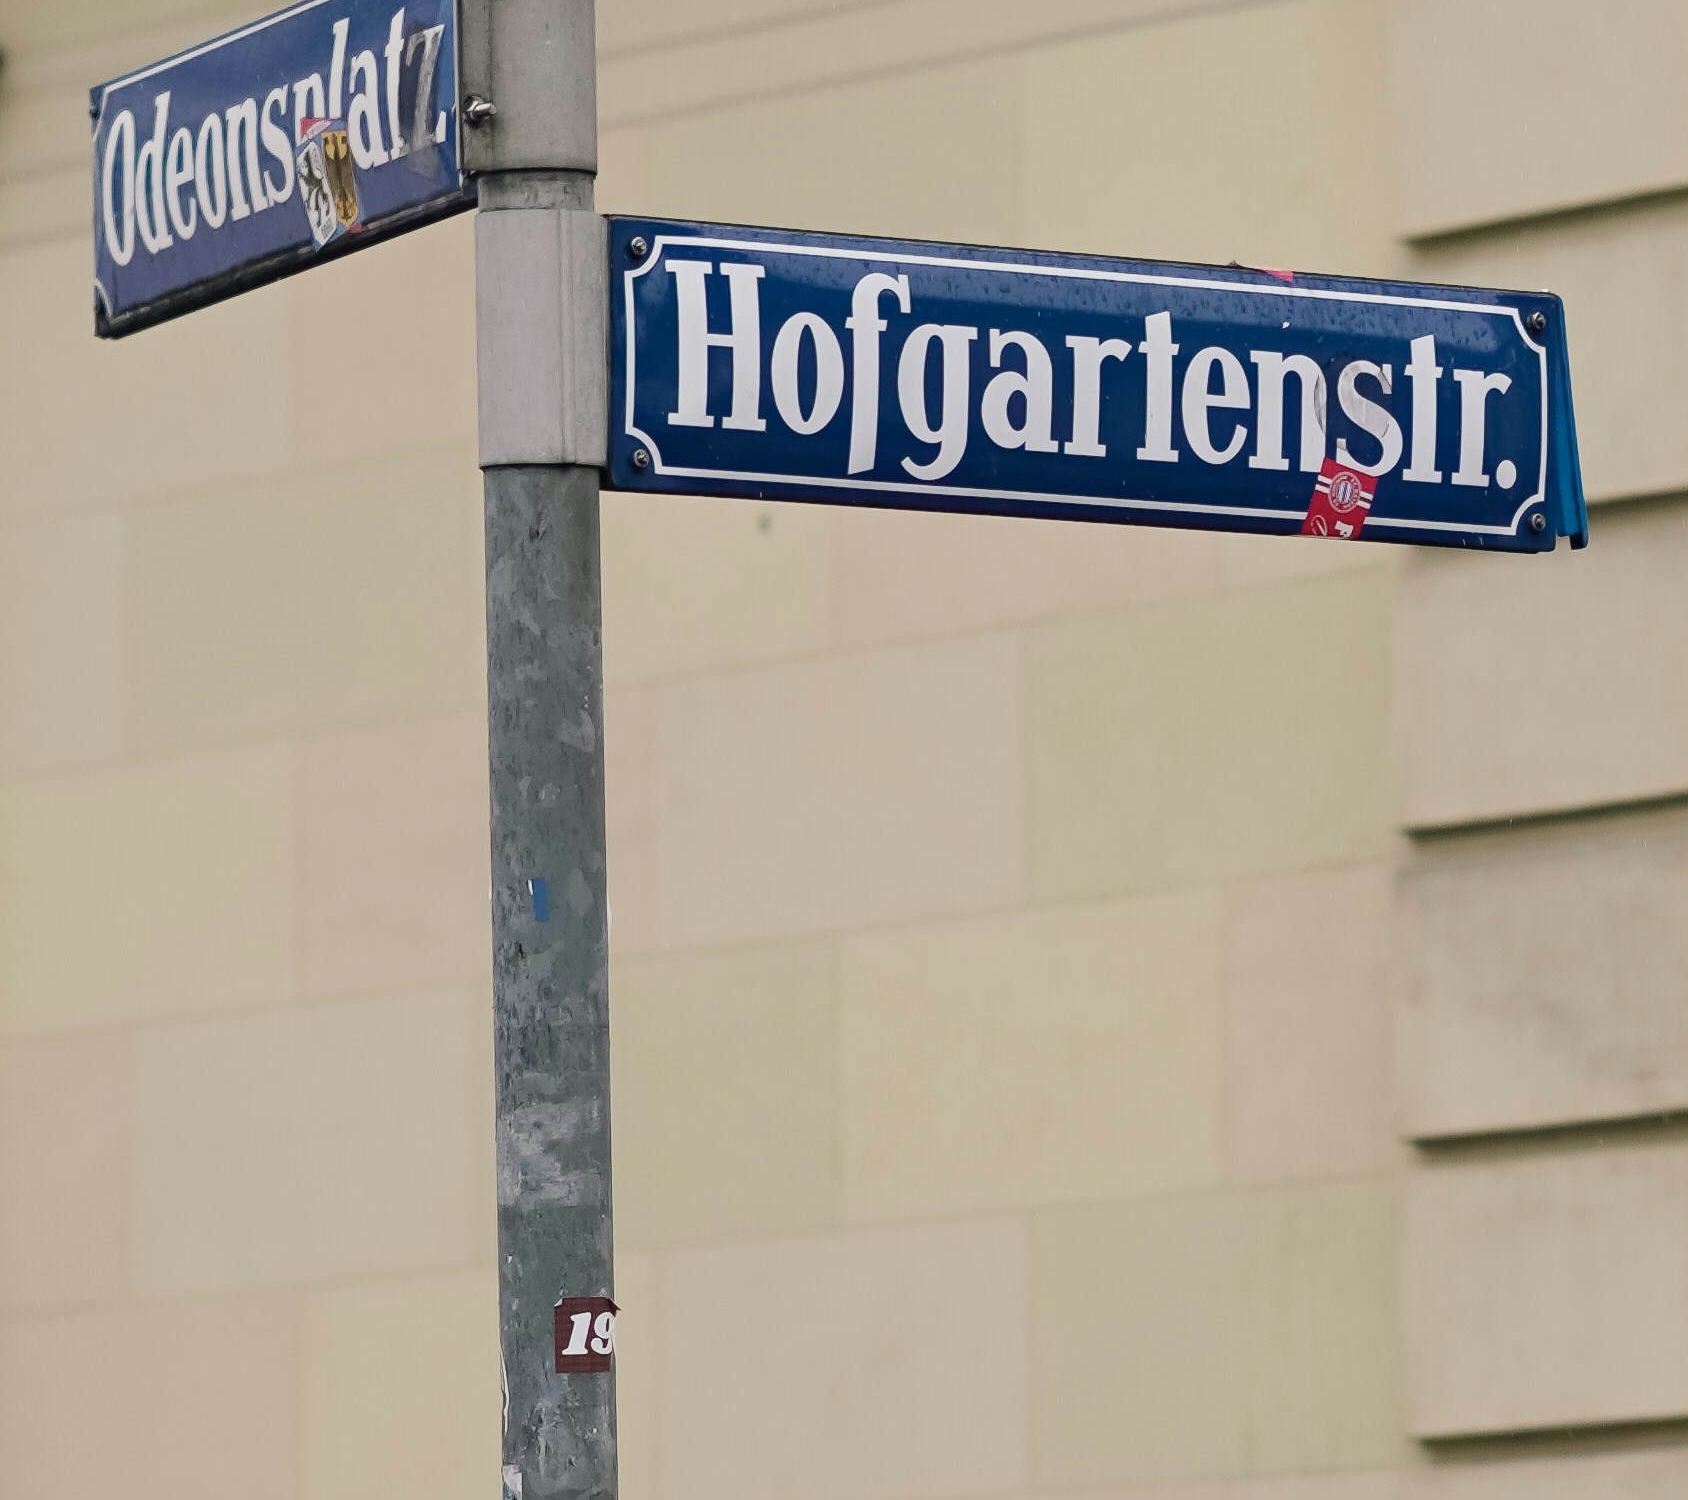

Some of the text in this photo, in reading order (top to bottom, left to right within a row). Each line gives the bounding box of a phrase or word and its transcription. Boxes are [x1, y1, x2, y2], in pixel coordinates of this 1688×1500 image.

[102, 6, 446, 267] Odeonsplatz
[663, 257, 1516, 491] Hofgartenstr.
[562, 1312, 614, 1355] 19
